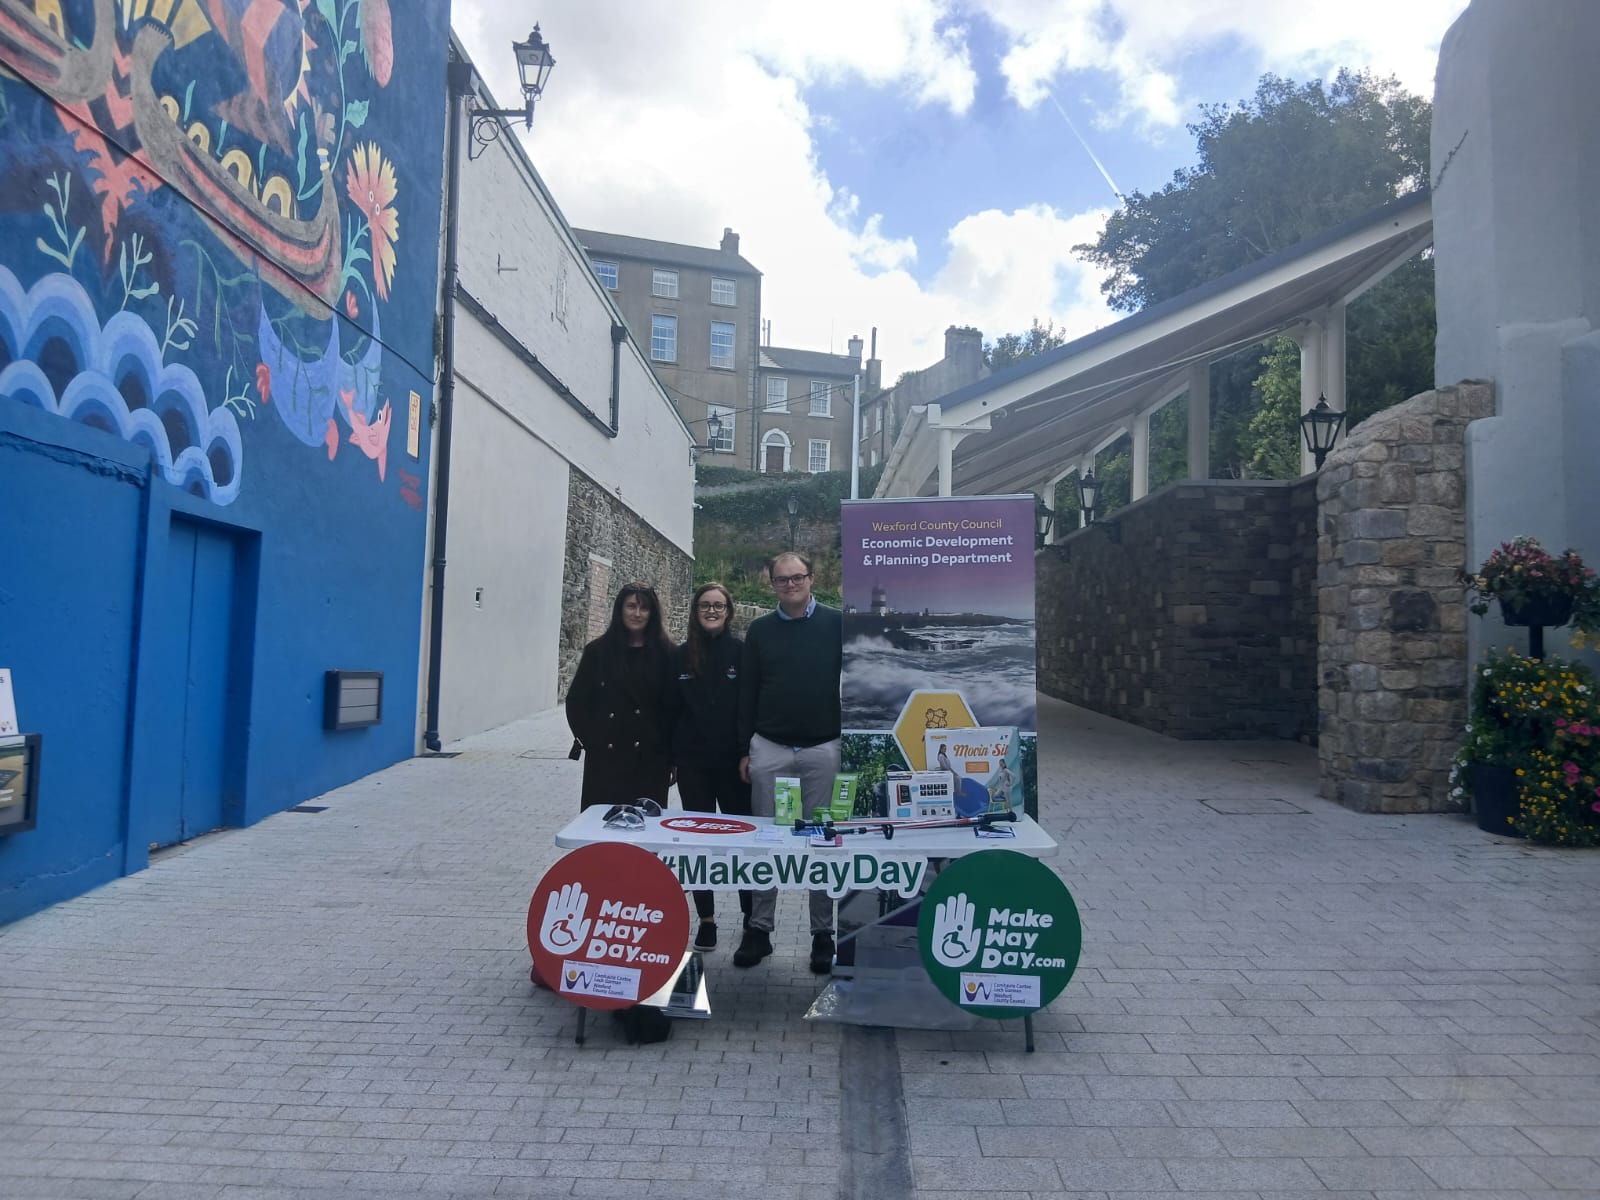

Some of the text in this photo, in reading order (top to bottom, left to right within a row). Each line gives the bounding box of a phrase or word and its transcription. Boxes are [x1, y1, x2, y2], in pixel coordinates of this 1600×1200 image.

[872, 519, 1002, 533] Wexford County Council
[862, 535, 1013, 549] Economic Development
[863, 552, 1013, 567] & Planning Department
[599, 899, 664, 924] Make
[988, 907, 1054, 928] Make
[593, 919, 648, 943] Way
[985, 928, 1039, 950] Way
[586, 938, 670, 965] Day.com
[980, 948, 1066, 969] Day.com
